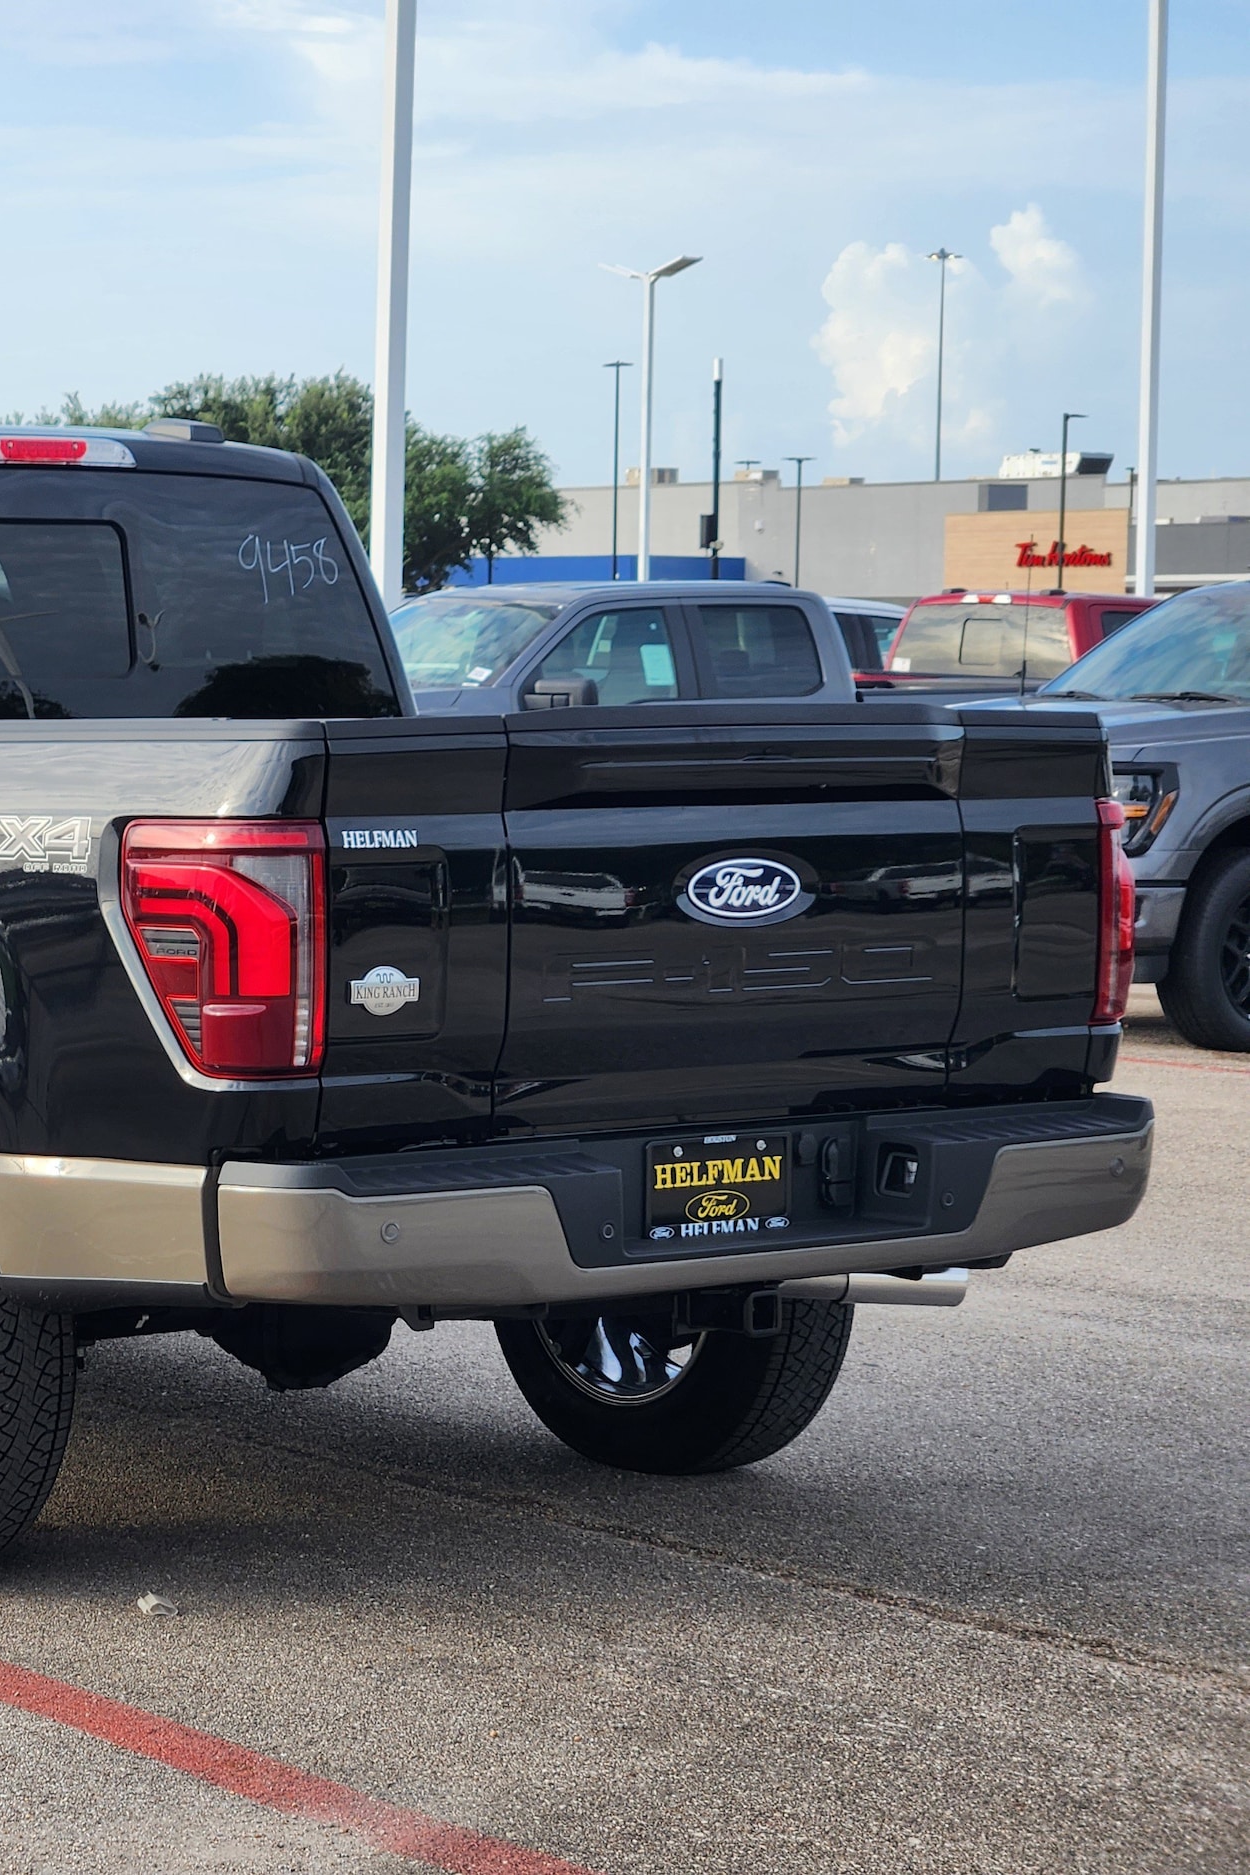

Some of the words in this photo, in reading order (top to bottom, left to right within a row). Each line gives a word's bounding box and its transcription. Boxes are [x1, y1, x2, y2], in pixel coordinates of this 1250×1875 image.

[238, 534, 339, 604] 9458
[341, 830, 418, 849] HELFMAN
[23, 862, 50, 873] OFF
[52, 863, 88, 874] ROAD
[708, 867, 782, 908] Ford
[156, 948, 197, 956] FORD
[542, 936, 937, 1002] F-150
[356, 984, 381, 999] KING
[382, 983, 416, 999] RANCH
[654, 1155, 783, 1190] HELFMAN
[697, 1194, 738, 1218] Ford
